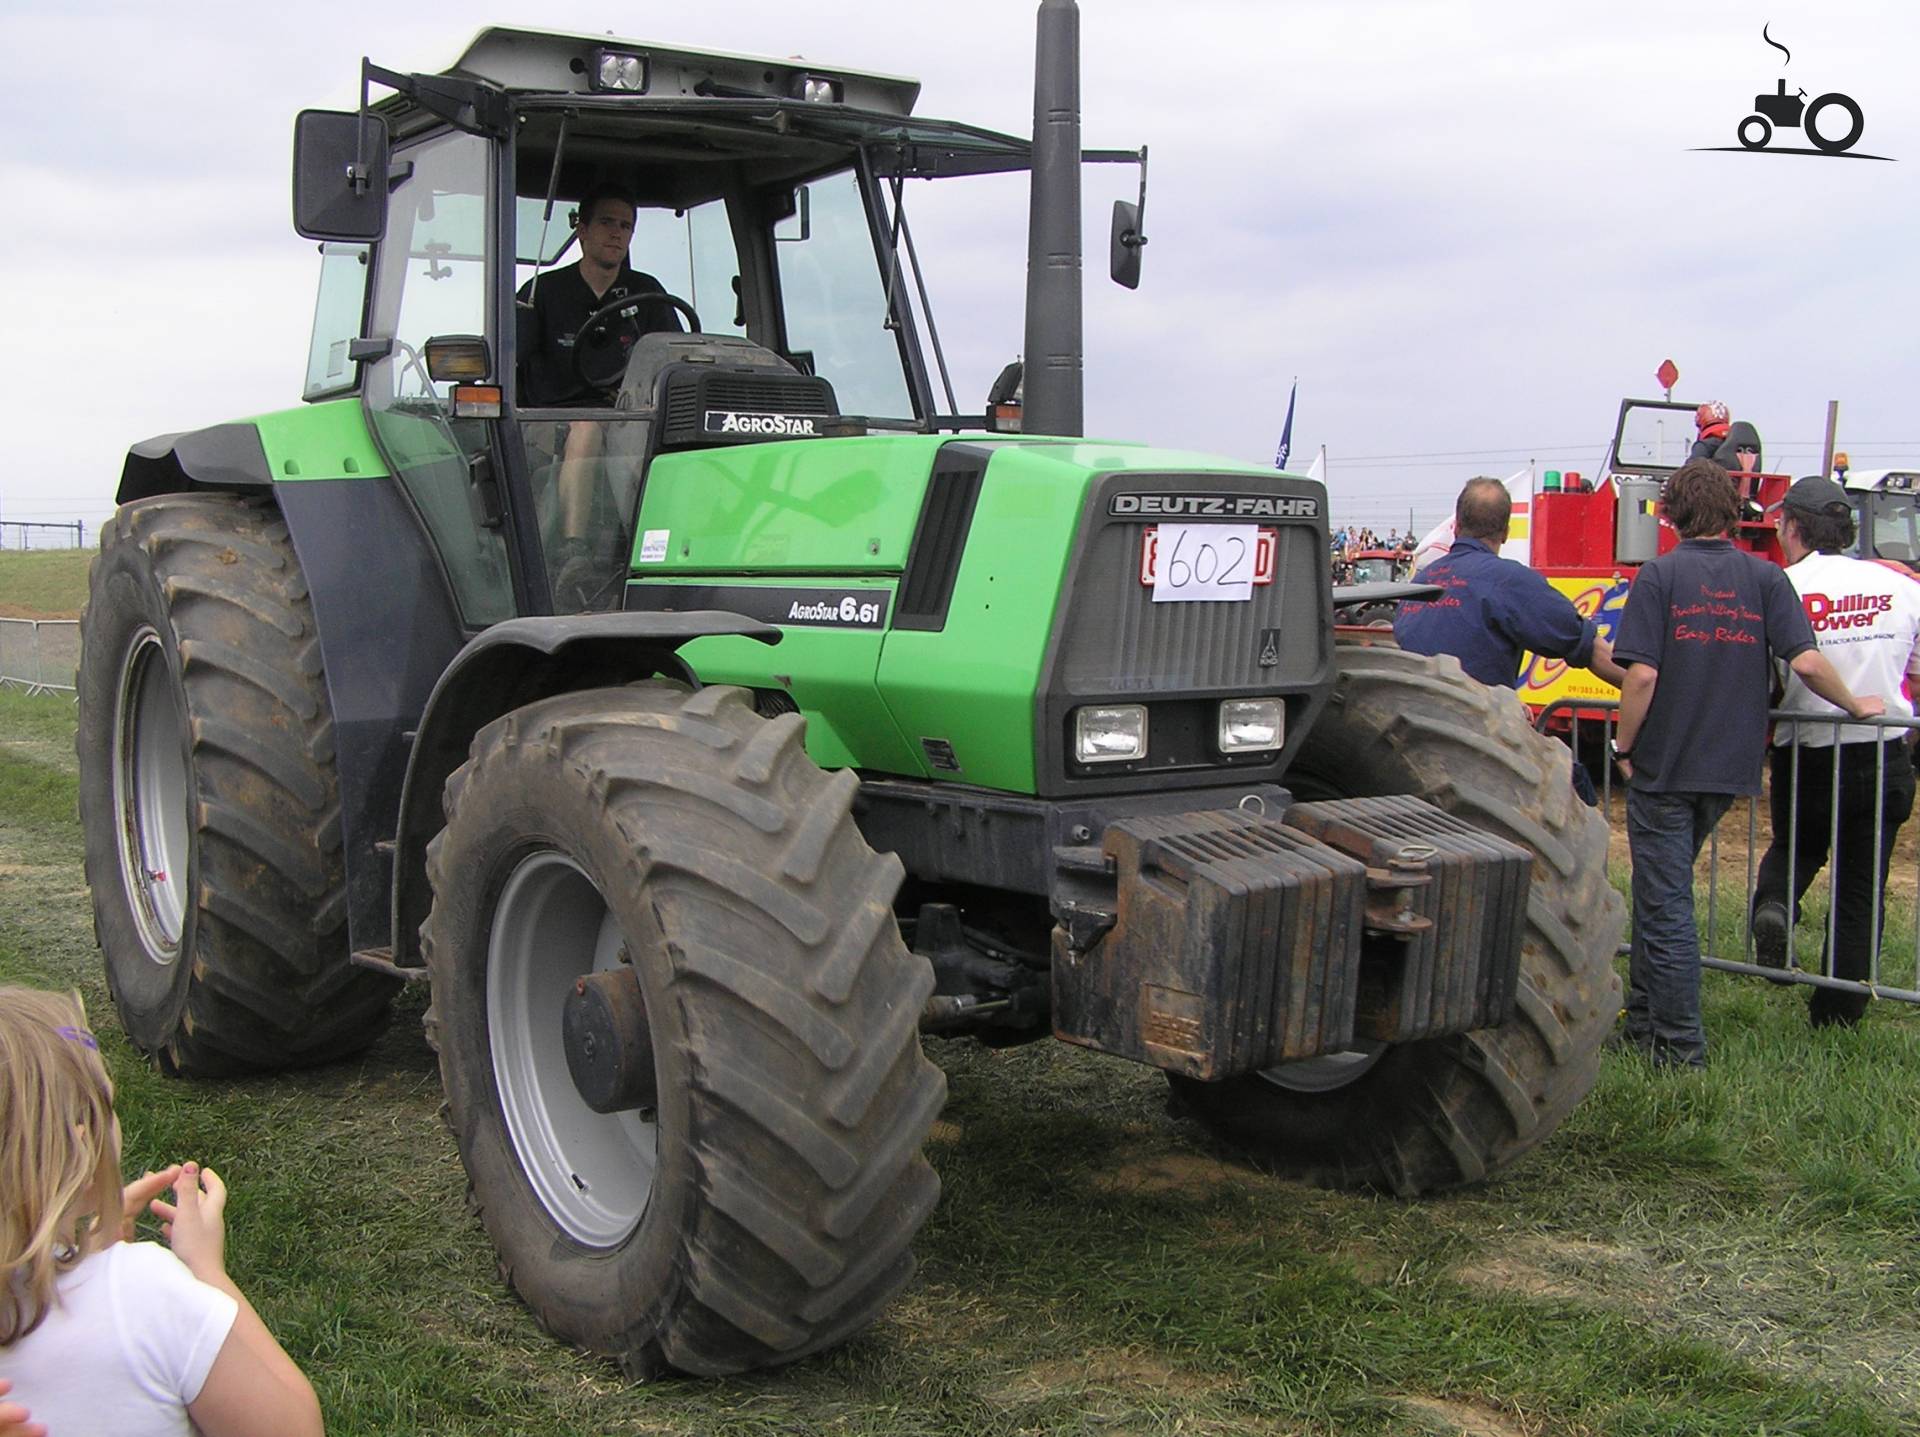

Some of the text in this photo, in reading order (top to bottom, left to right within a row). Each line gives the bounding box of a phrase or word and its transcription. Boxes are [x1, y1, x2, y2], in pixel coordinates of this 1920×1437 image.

[1115, 496, 1317, 516] DEUTZ-FAHR
[1169, 529, 1248, 588] 602
[840, 596, 879, 623] 6.61
[1802, 593, 1893, 621] Pulling
[1714, 627, 1757, 643] Rider
